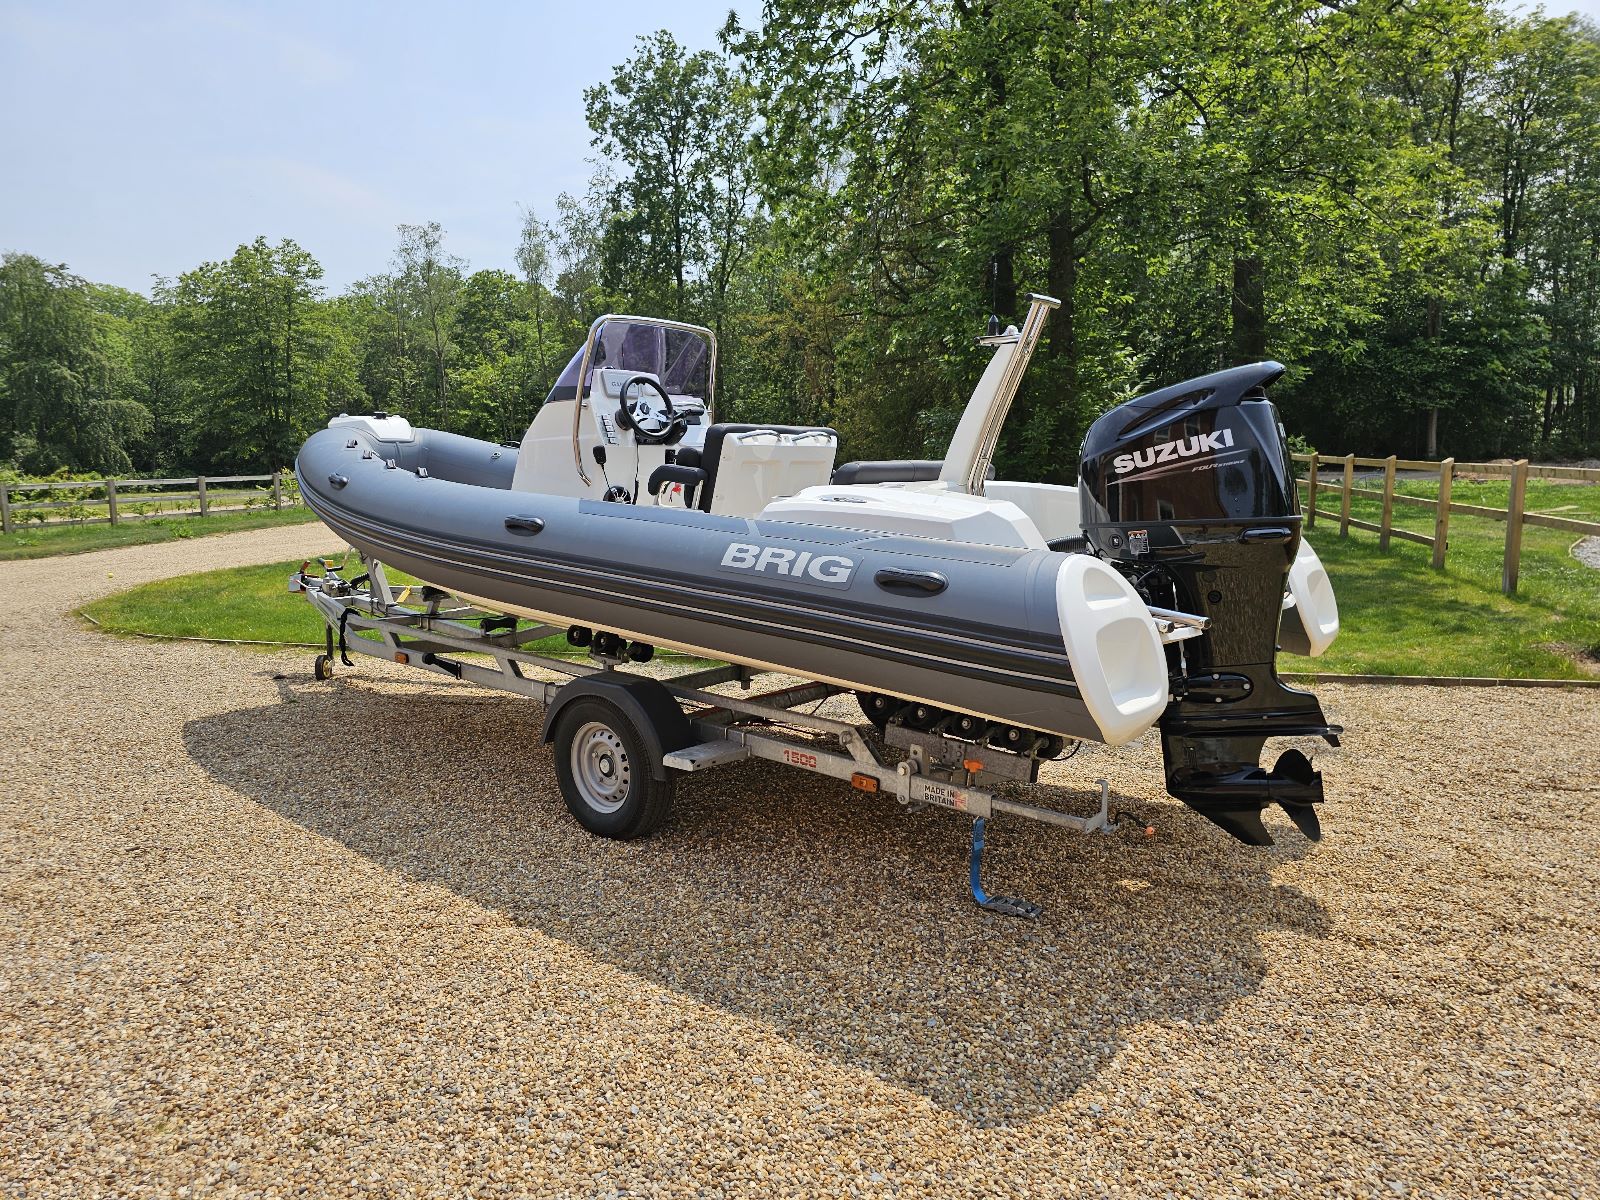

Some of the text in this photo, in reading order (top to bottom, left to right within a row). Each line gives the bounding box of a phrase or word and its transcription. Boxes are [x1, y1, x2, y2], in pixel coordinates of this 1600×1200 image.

[1113, 428, 1234, 474] SUZUKI
[720, 542, 853, 583] BRIG
[783, 749, 817, 768] 1500
[924, 784, 955, 798] MADE IN
[924, 792, 955, 807] BRITAIN
